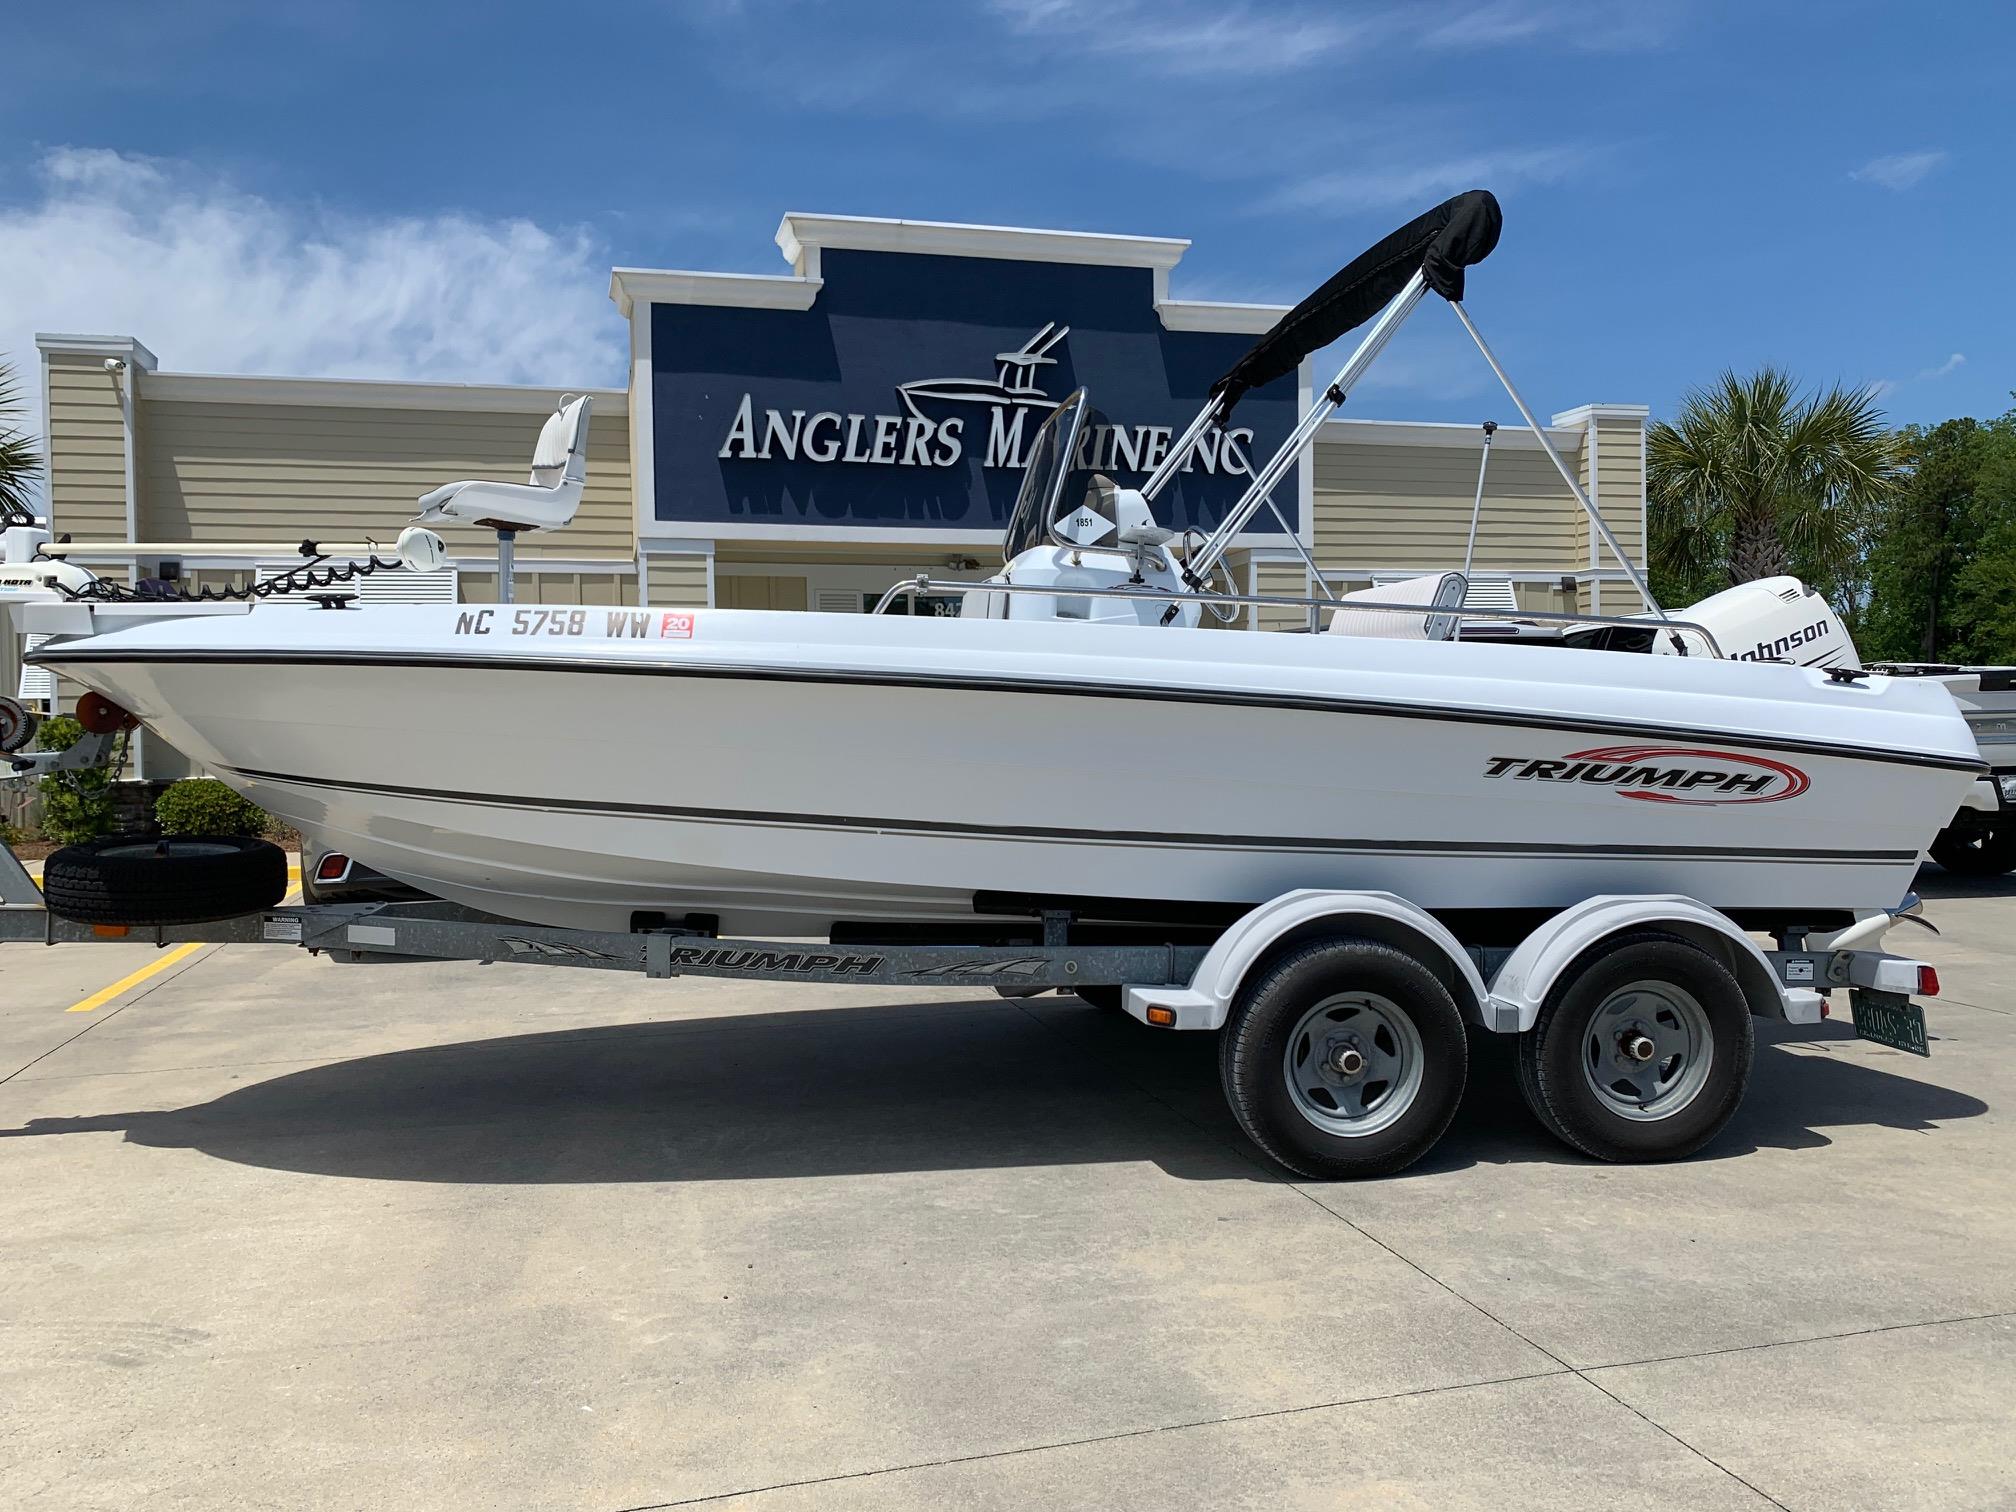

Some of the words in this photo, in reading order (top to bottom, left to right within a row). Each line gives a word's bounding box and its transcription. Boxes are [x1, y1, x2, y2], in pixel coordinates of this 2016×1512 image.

[718, 393, 964, 467] ANGLERS
[984, 406, 1173, 472] MRINE
[1075, 518, 1093, 527] 1851
[455, 610, 494, 635] NC
[511, 610, 586, 635] 5758
[606, 611, 651, 638] WW
[666, 617, 690, 630] 20
[1483, 757, 1777, 795] TRIUMPH
